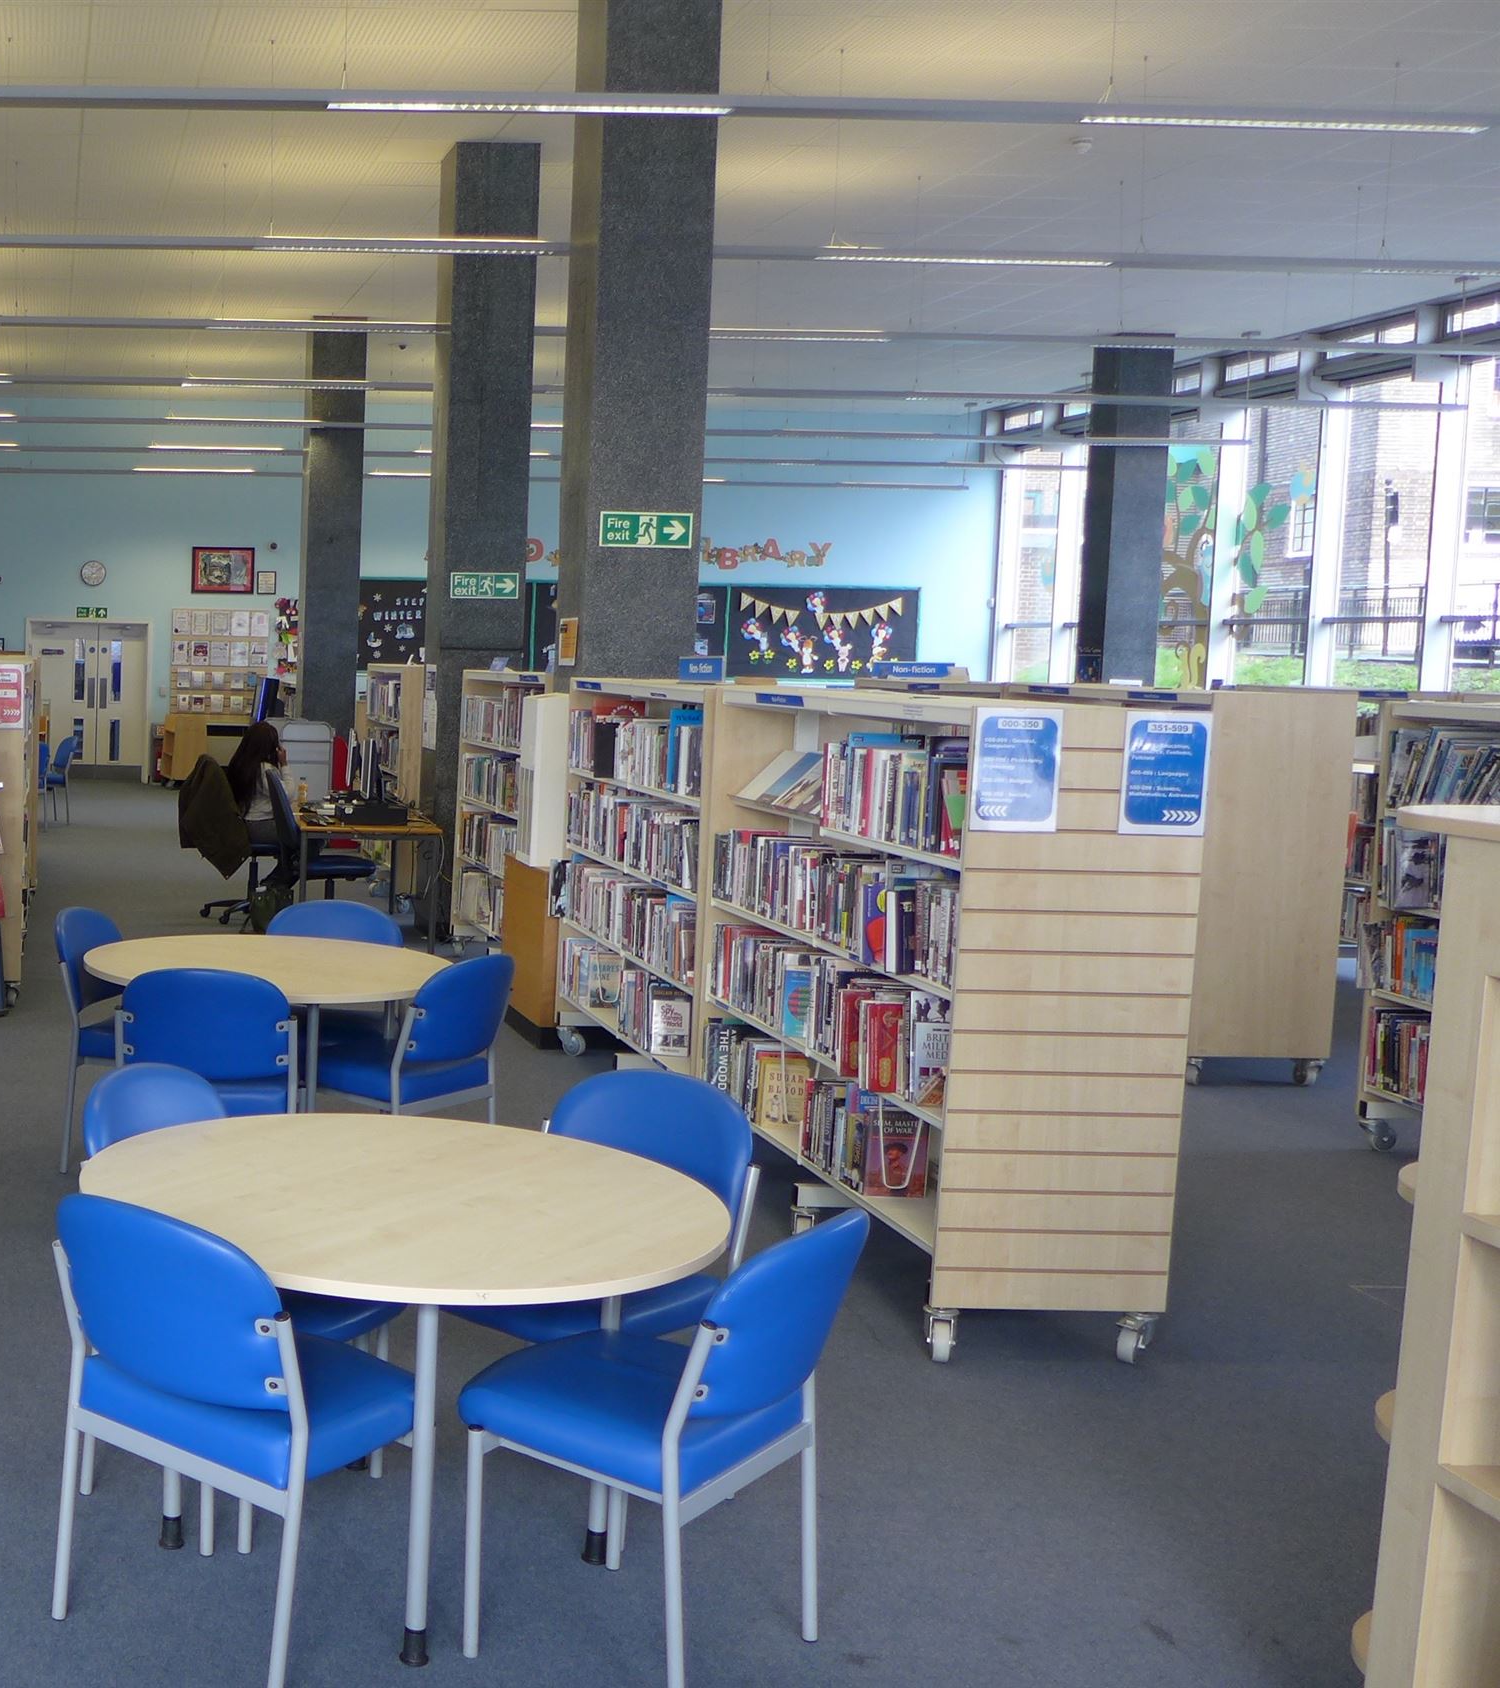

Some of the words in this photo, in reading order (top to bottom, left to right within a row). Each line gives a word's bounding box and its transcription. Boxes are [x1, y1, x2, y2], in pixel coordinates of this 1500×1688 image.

[606, 518, 631, 529] Fire
[606, 530, 631, 541] exit
[453, 575, 478, 587] Fire
[453, 586, 478, 596] exit
[373, 609, 422, 621] WINTER
[892, 665, 937, 675] Non-fiction
[1001, 719, 1040, 728] 000-350
[1150, 723, 1189, 733] 351-599
[719, 1029, 730, 1052] THE
